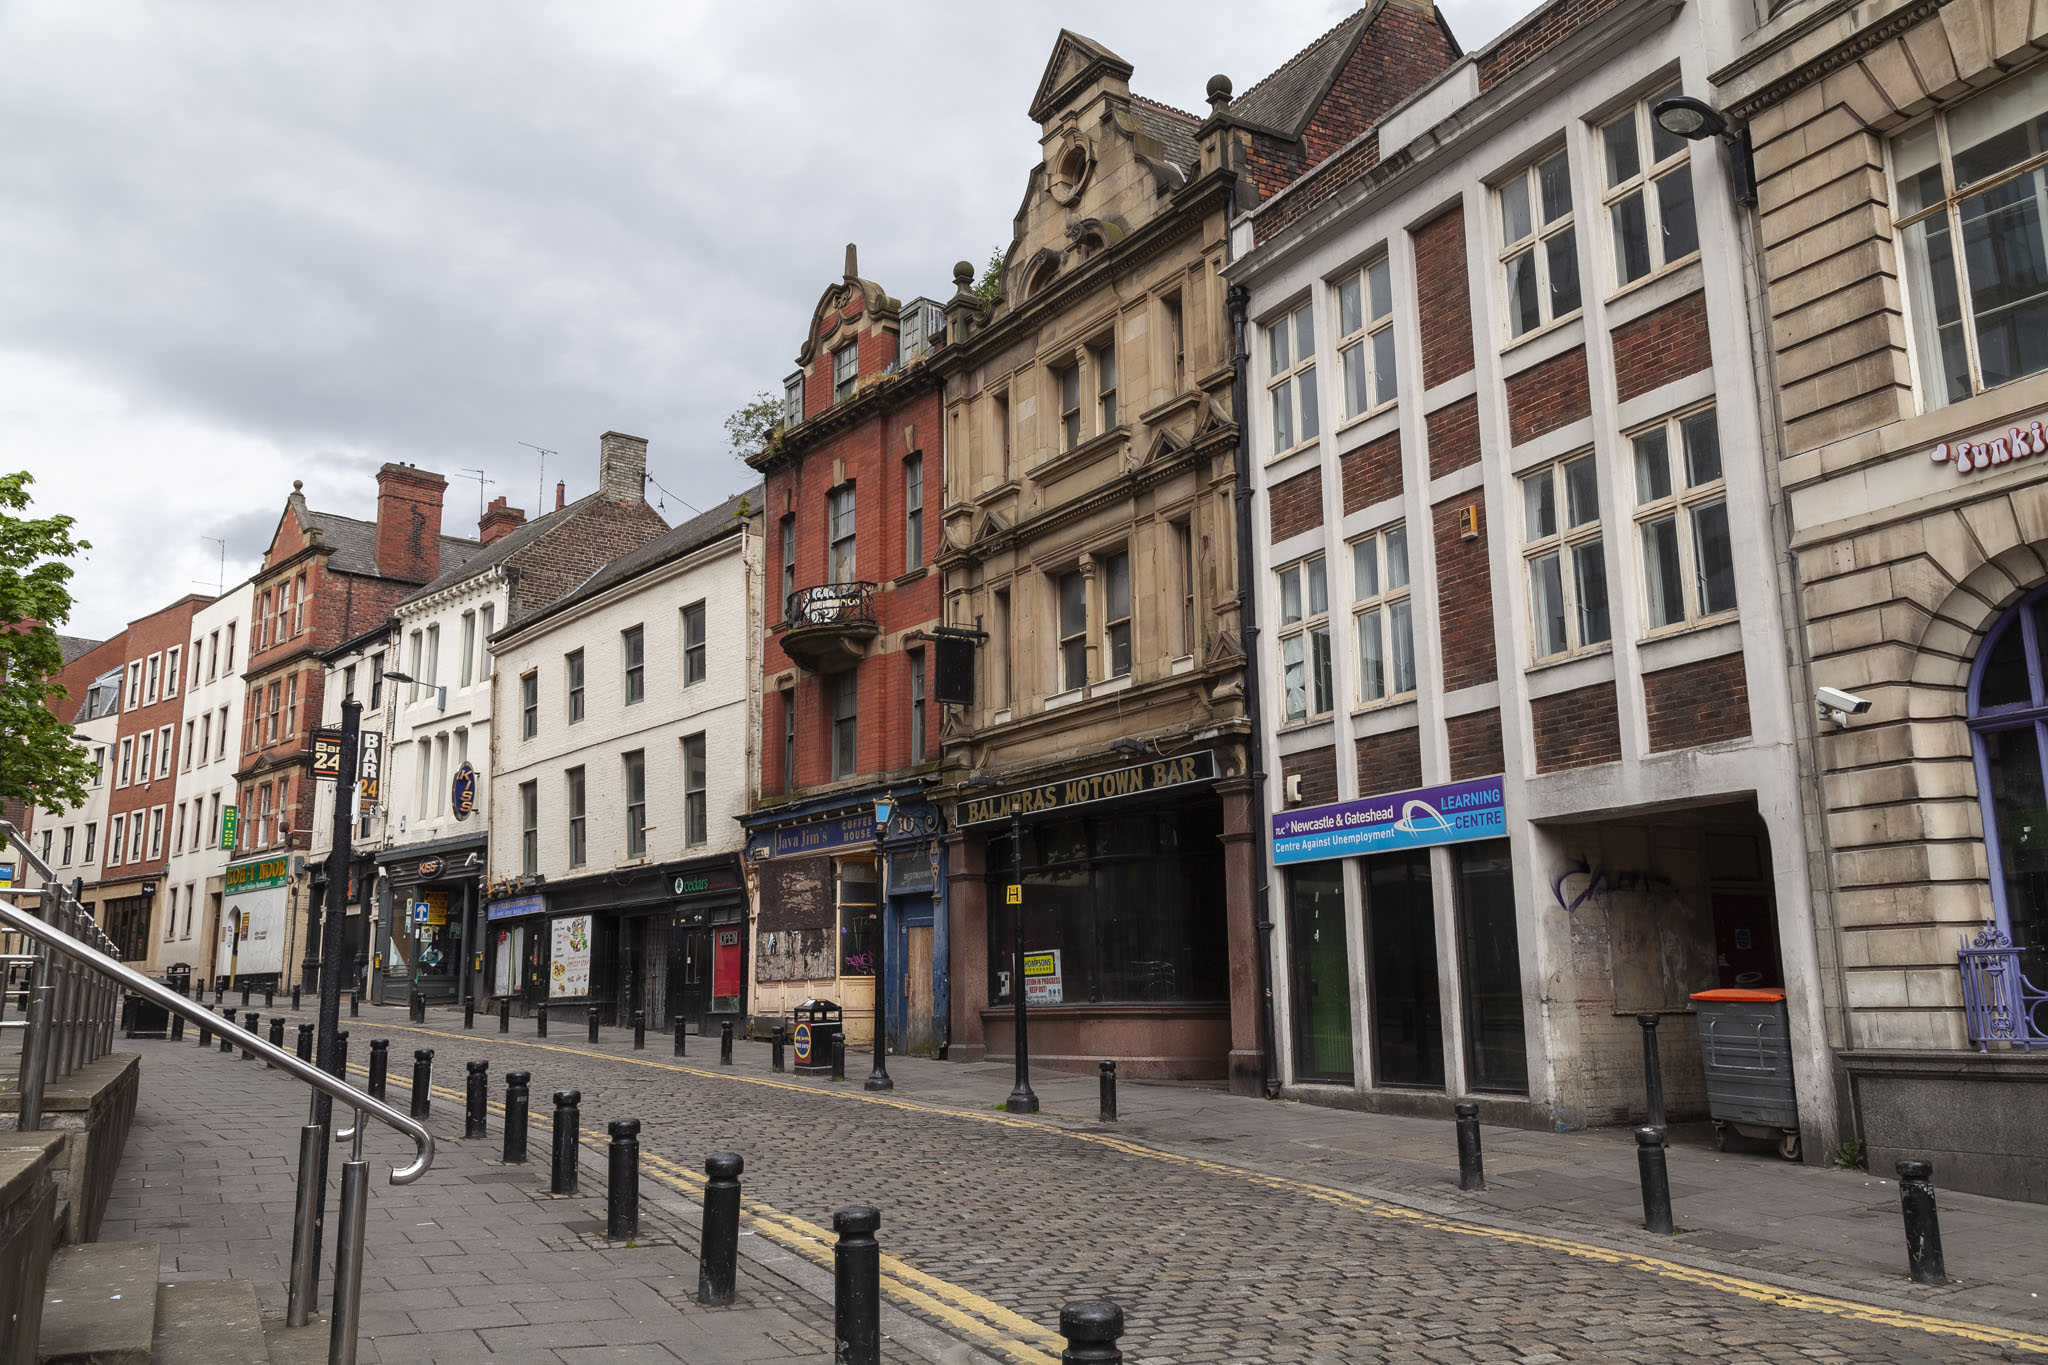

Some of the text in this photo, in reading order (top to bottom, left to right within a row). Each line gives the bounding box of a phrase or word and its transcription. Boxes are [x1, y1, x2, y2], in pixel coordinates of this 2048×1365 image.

[1957, 421, 2048, 474] funki
[315, 742, 340, 753] Bar
[362, 733, 379, 778] BAR
[314, 752, 340, 771] 24
[360, 778, 377, 797] 24
[460, 770, 473, 812] KISS
[967, 757, 1197, 823] BALMBRAS MOTOWN BAR
[1440, 788, 1501, 810] LEARNING
[841, 816, 873, 831] COFFEE
[897, 816, 914, 834] 10
[1275, 805, 1394, 835] TUC Newcastle & Gateshead
[1455, 810, 1502, 829] CENTRE
[777, 827, 828, 850] Java Jim's
[843, 828, 872, 842] HOUSE
[1275, 828, 1395, 852] Centre Against Unemployment
[683, 876, 709, 892] cedars
[1008, 887, 1019, 902] H
[720, 932, 738, 945] OPEN
[1024, 958, 1051, 968] HOMPSONS
[1041, 977, 1061, 985] PROGRESS
